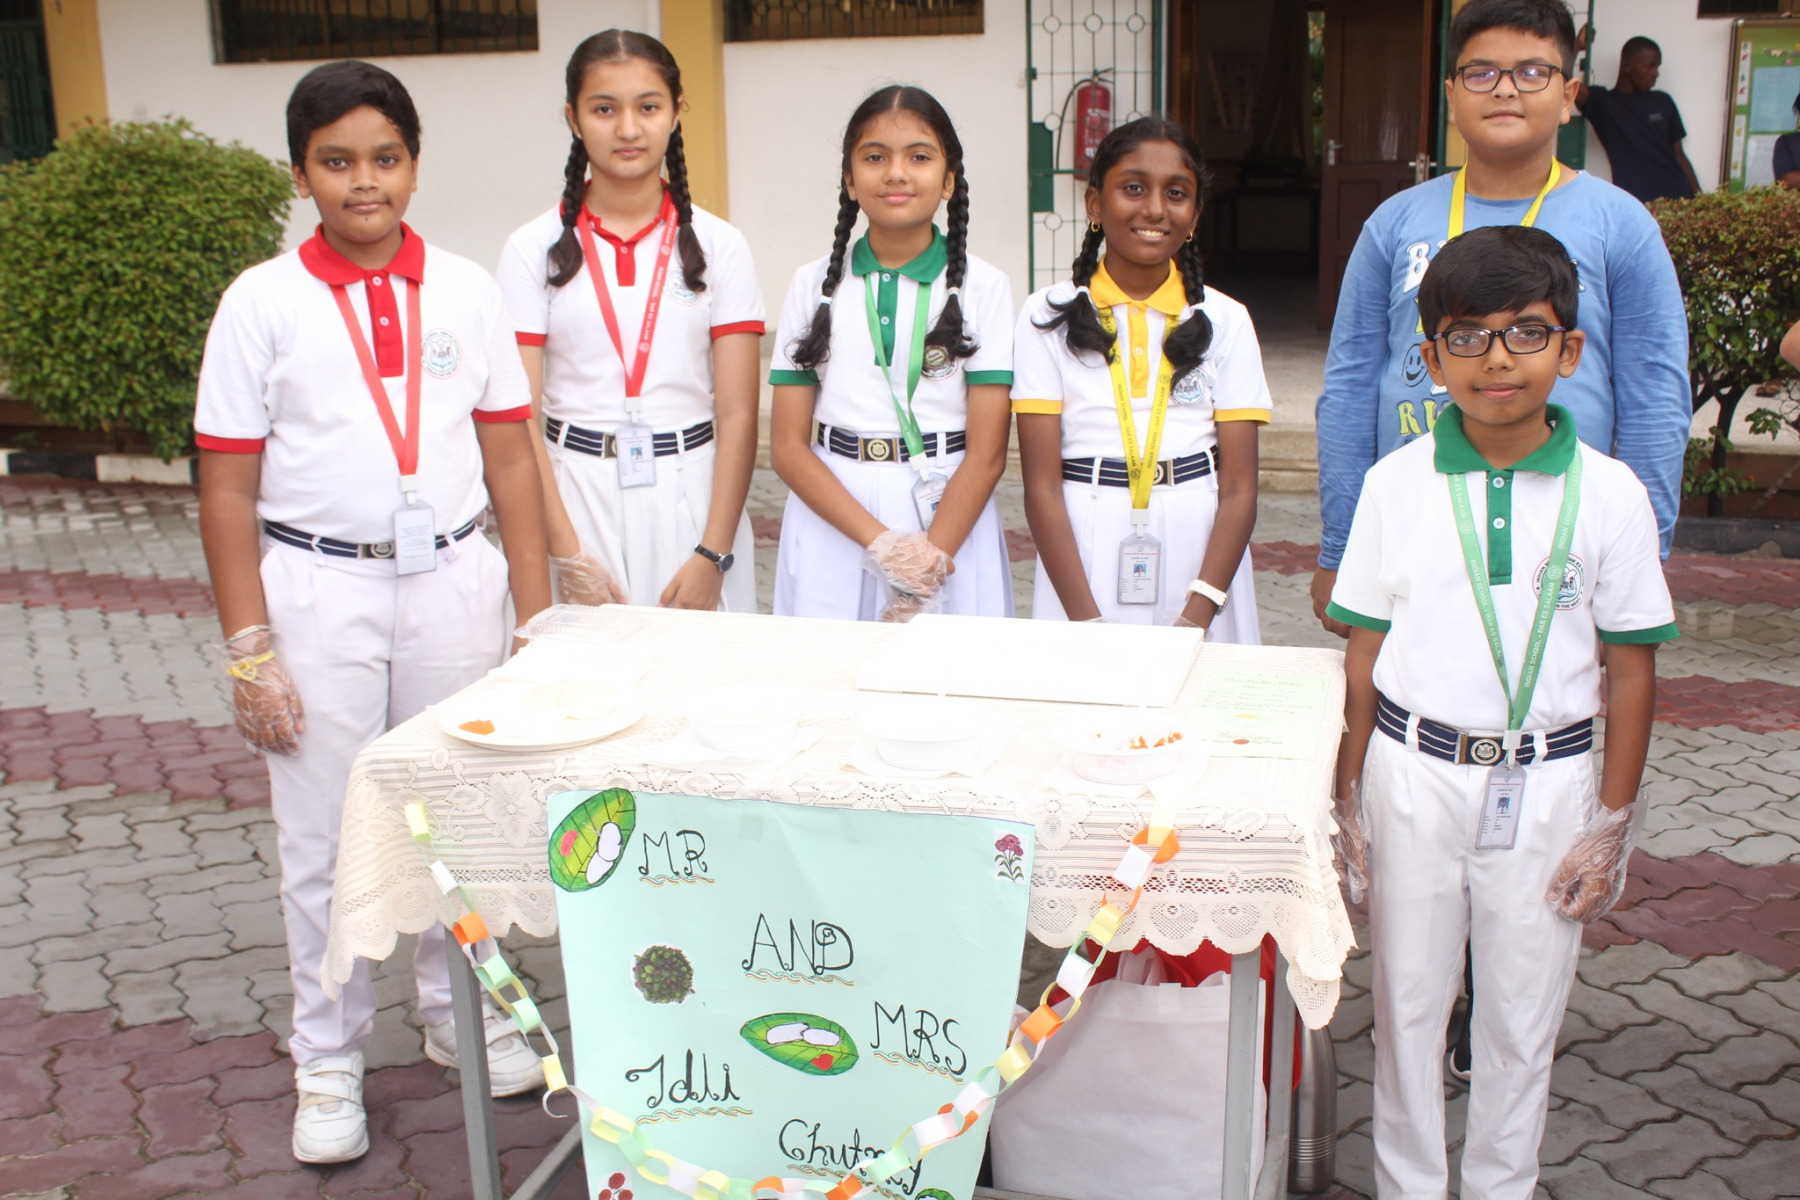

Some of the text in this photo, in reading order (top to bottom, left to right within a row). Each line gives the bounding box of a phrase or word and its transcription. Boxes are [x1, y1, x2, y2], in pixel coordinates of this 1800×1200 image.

[1456, 492, 1467, 518] SALAAM
[1558, 527, 1568, 549] INDIAN
[1470, 559, 1481, 583] INDIAN
[1477, 583, 1489, 608] SCHOOL
[1544, 582, 1556, 610] SALAAM
[1537, 620, 1547, 634] DAR
[1541, 610, 1549, 620] ES
[1529, 639, 1542, 665] SCHOOL
[1523, 665, 1535, 688] INDIAN
[638, 829, 708, 877] MR
[741, 912, 855, 977] AND
[871, 1001, 968, 1076] MRS
